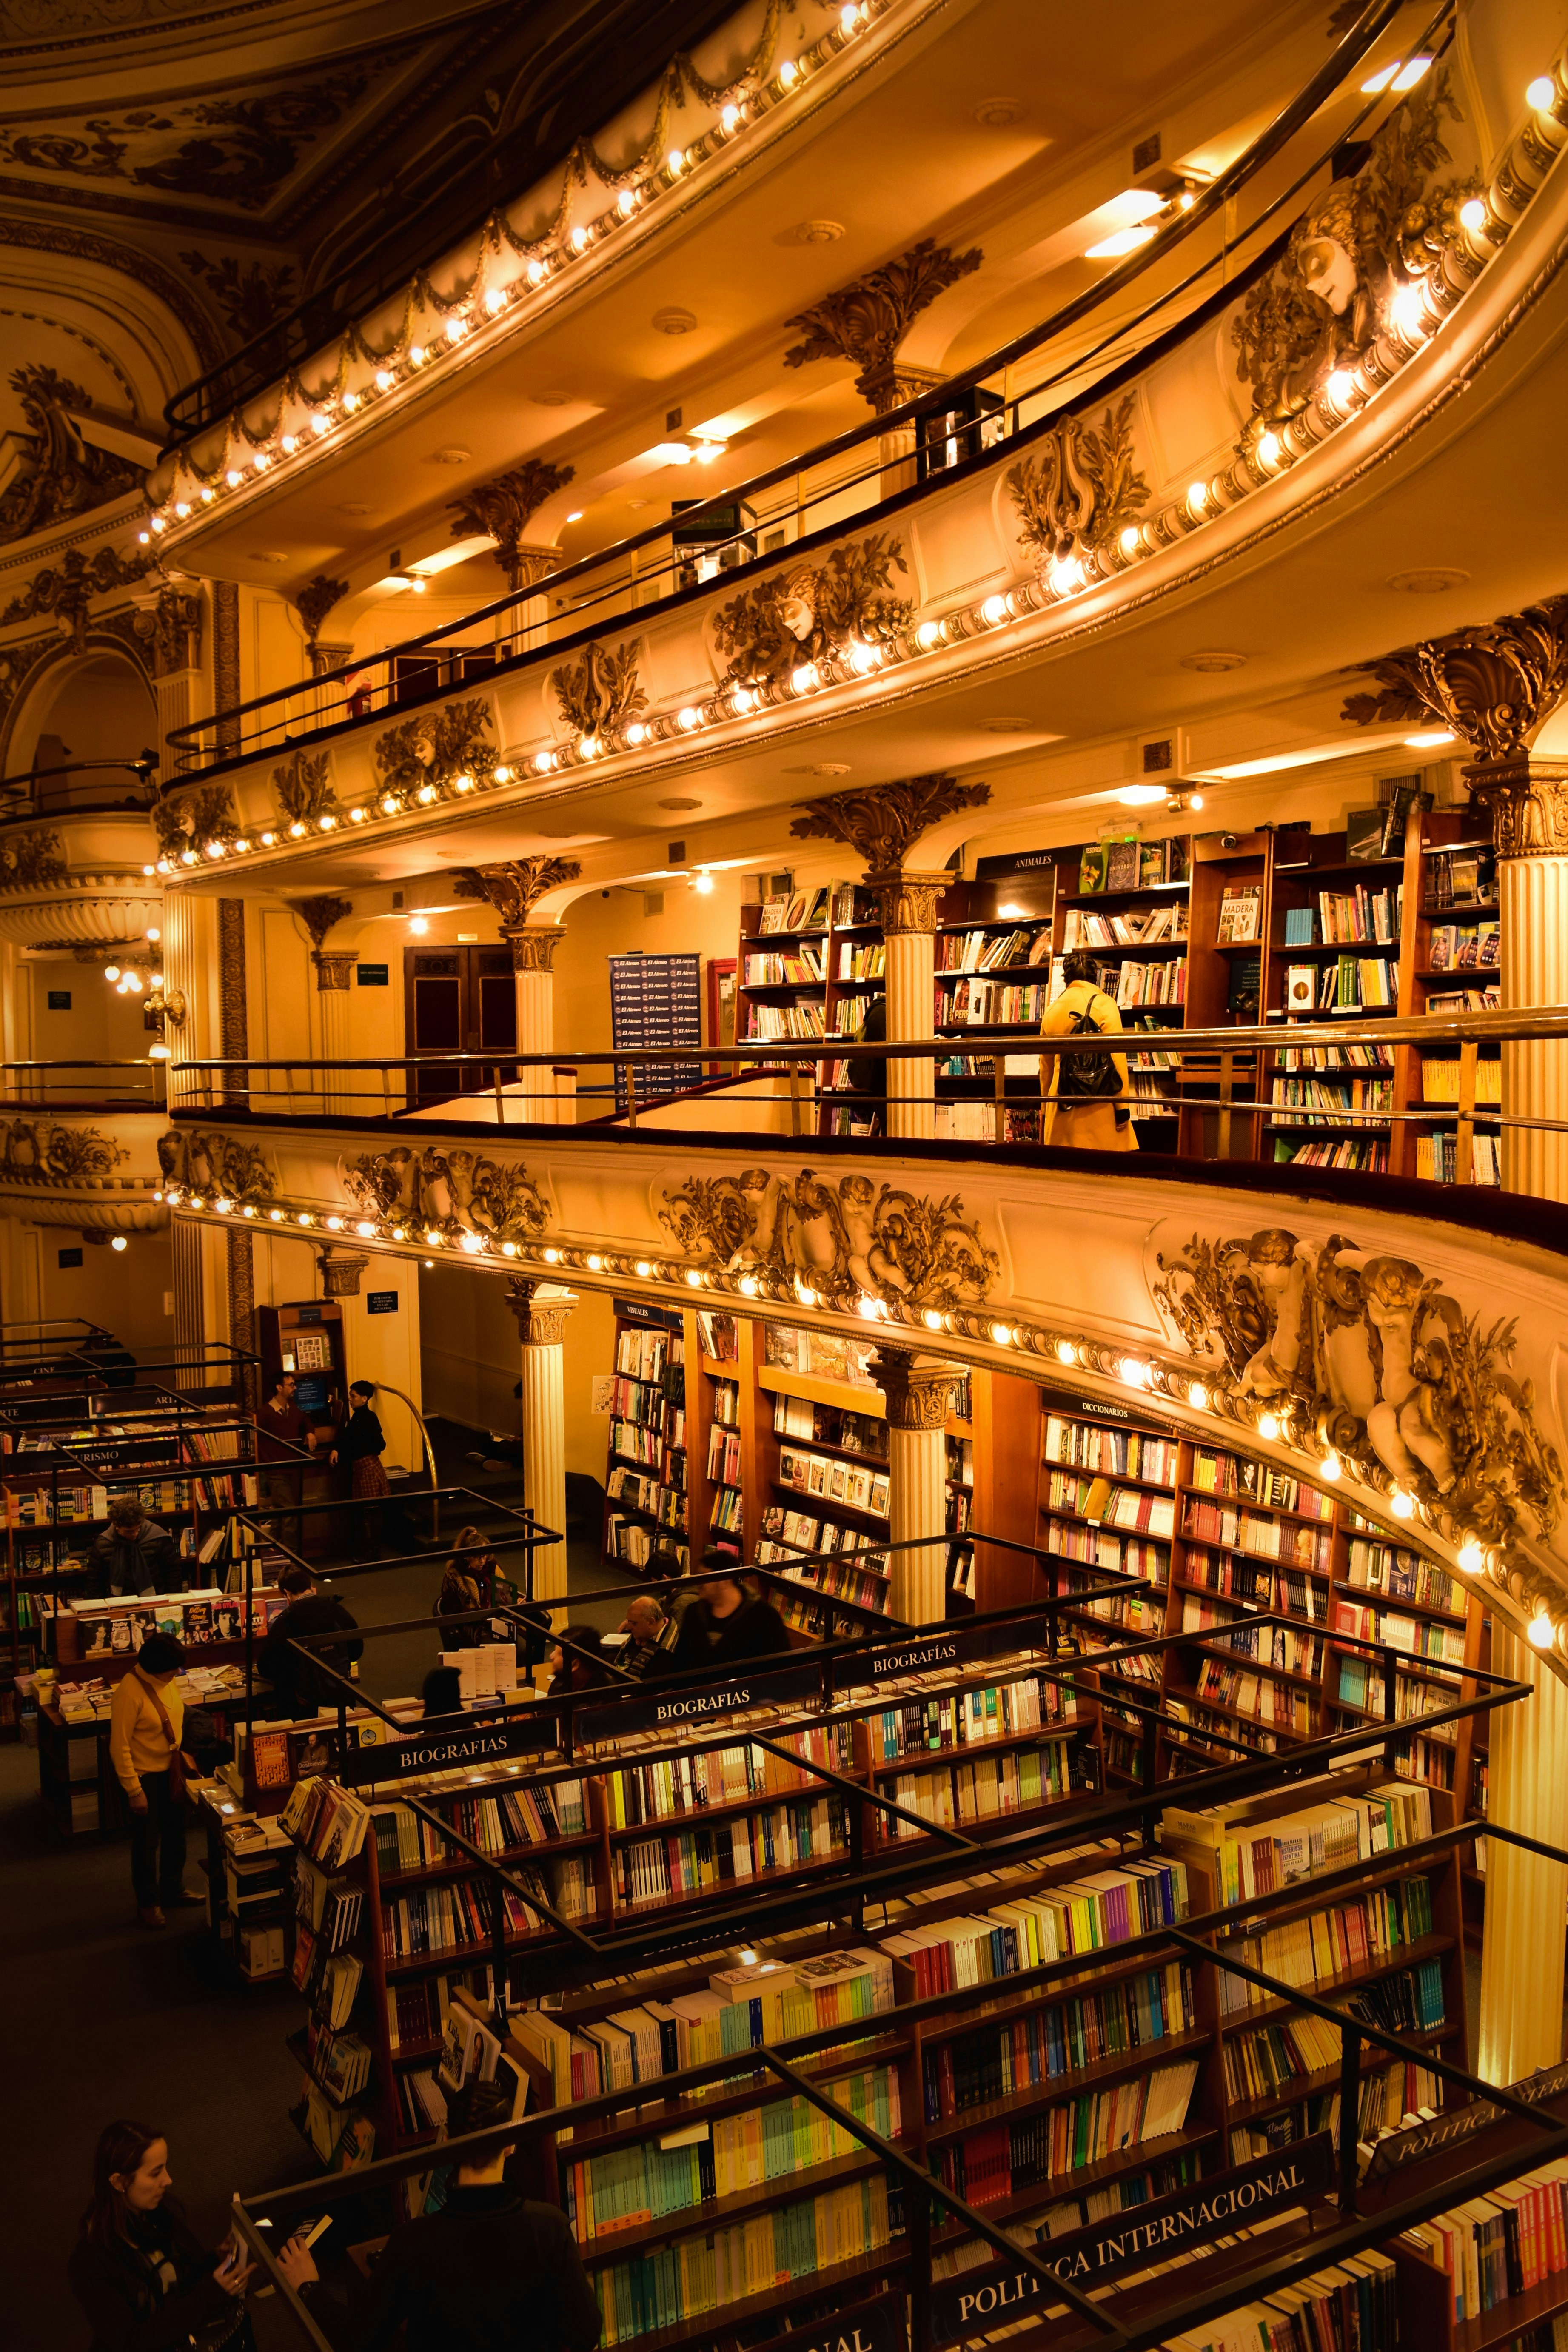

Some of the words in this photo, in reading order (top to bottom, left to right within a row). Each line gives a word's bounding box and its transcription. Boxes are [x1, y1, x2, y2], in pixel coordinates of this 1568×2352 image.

[1015, 855, 1052, 868] ANIMALES
[1224, 904, 1254, 914] MADERA
[627, 1306, 648, 1317] VISUALES
[1082, 1402, 1128, 1418] DICCIONARIOS
[74, 1451, 119, 1462] URISMO
[1114, 1596, 1122, 1619] Maratón
[873, 1644, 957, 1673] BIOGRAFÍAS
[656, 1689, 750, 1721] BIOGRAFIAS
[399, 1736, 508, 1768] BIOGRAFIAS
[1177, 1821, 1196, 1829] MAPAS
[1282, 1852, 1300, 1861] RGENTINA
[831, 1955, 857, 1969] FLORES
[448, 2018, 460, 2042] Lula
[959, 2251, 1090, 2322] POLITCA
[1096, 2164, 1305, 2268] INTERNACIONAL
